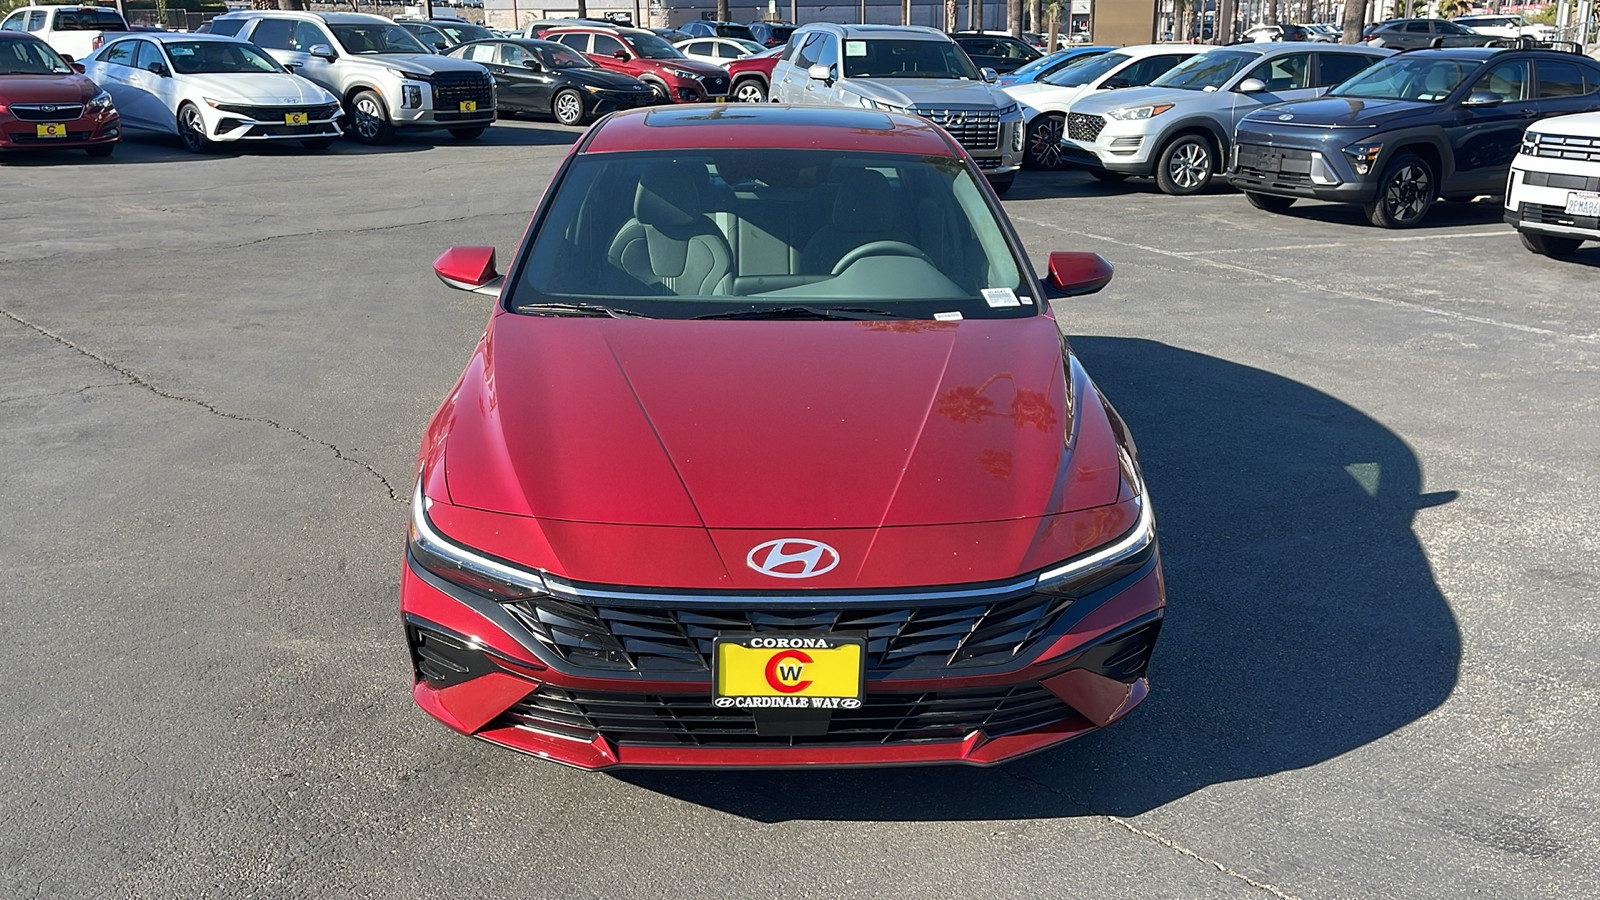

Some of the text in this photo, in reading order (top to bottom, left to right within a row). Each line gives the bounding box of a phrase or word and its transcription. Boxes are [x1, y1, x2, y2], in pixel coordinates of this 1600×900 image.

[750, 638, 829, 649] CORONA
[735, 697, 841, 709] CARDINALE WAY
